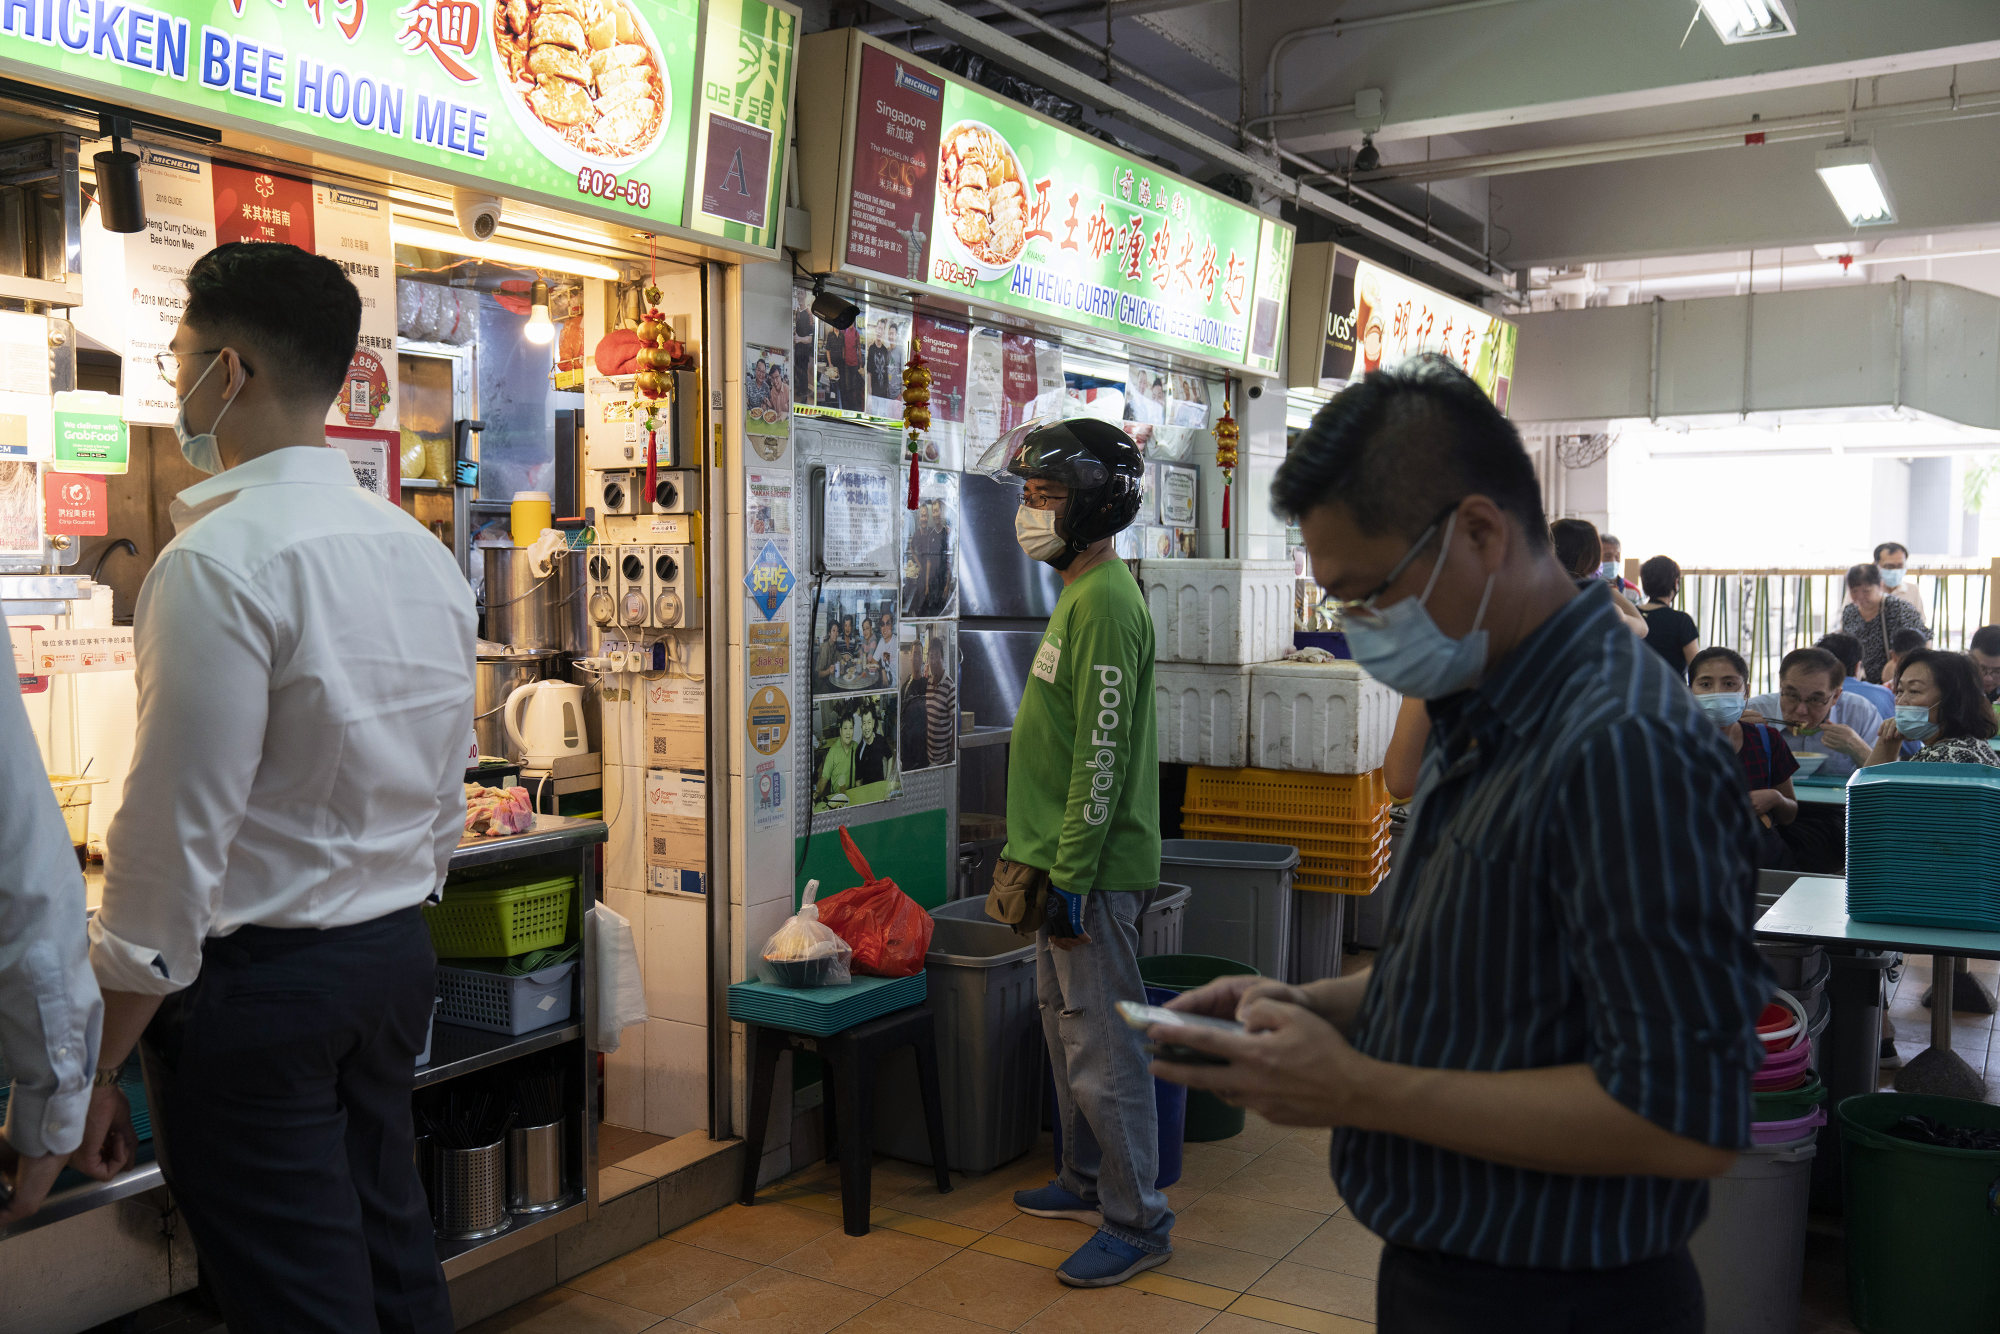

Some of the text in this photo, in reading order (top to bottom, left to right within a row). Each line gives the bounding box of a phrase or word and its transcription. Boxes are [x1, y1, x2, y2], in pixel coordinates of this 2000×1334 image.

[203, 30, 284, 103] BEE
[297, 59, 403, 134] HOON
[415, 93, 488, 157] MEE
[904, 77, 938, 97] MICHELIN
[876, 100, 926, 131] Singapore
[886, 122, 914, 144] 新加坡
[152, 155, 199, 171] MICHELIN
[870, 142, 926, 169] The MICHELIN Guide
[719, 145, 750, 197] A
[878, 155, 916, 186] 2016
[578, 167, 651, 209] #02-58
[168, 196, 183, 206] GUIDE
[339, 195, 377, 208] MICHELIN
[242, 203, 291, 227] 米其林指南
[145, 217, 207, 237] Heng Curry Chicken
[260, 226, 275, 237] THE
[150, 233, 195, 250] Bee Hoon Mee
[1027, 251, 1046, 264] KWANG
[152, 264, 173, 274] MICHELIN
[935, 259, 978, 289] #02-57
[141, 294, 156, 306] 2018
[1010, 263, 1243, 352] AH HENG CURRY CHICKEN BEE HOON MEE
[923, 335, 958, 350] Singapore
[1009, 371, 1031, 382] MICHELIN
[145, 399, 168, 408] MICHELIN
[64, 421, 75, 429] We
[76, 422, 102, 430] deliver
[64, 430, 119, 442] GrabFood
[73, 518, 96, 526] Gourmet
[753, 565, 789, 593] 好吃
[1083, 665, 1123, 826] GrabFood
